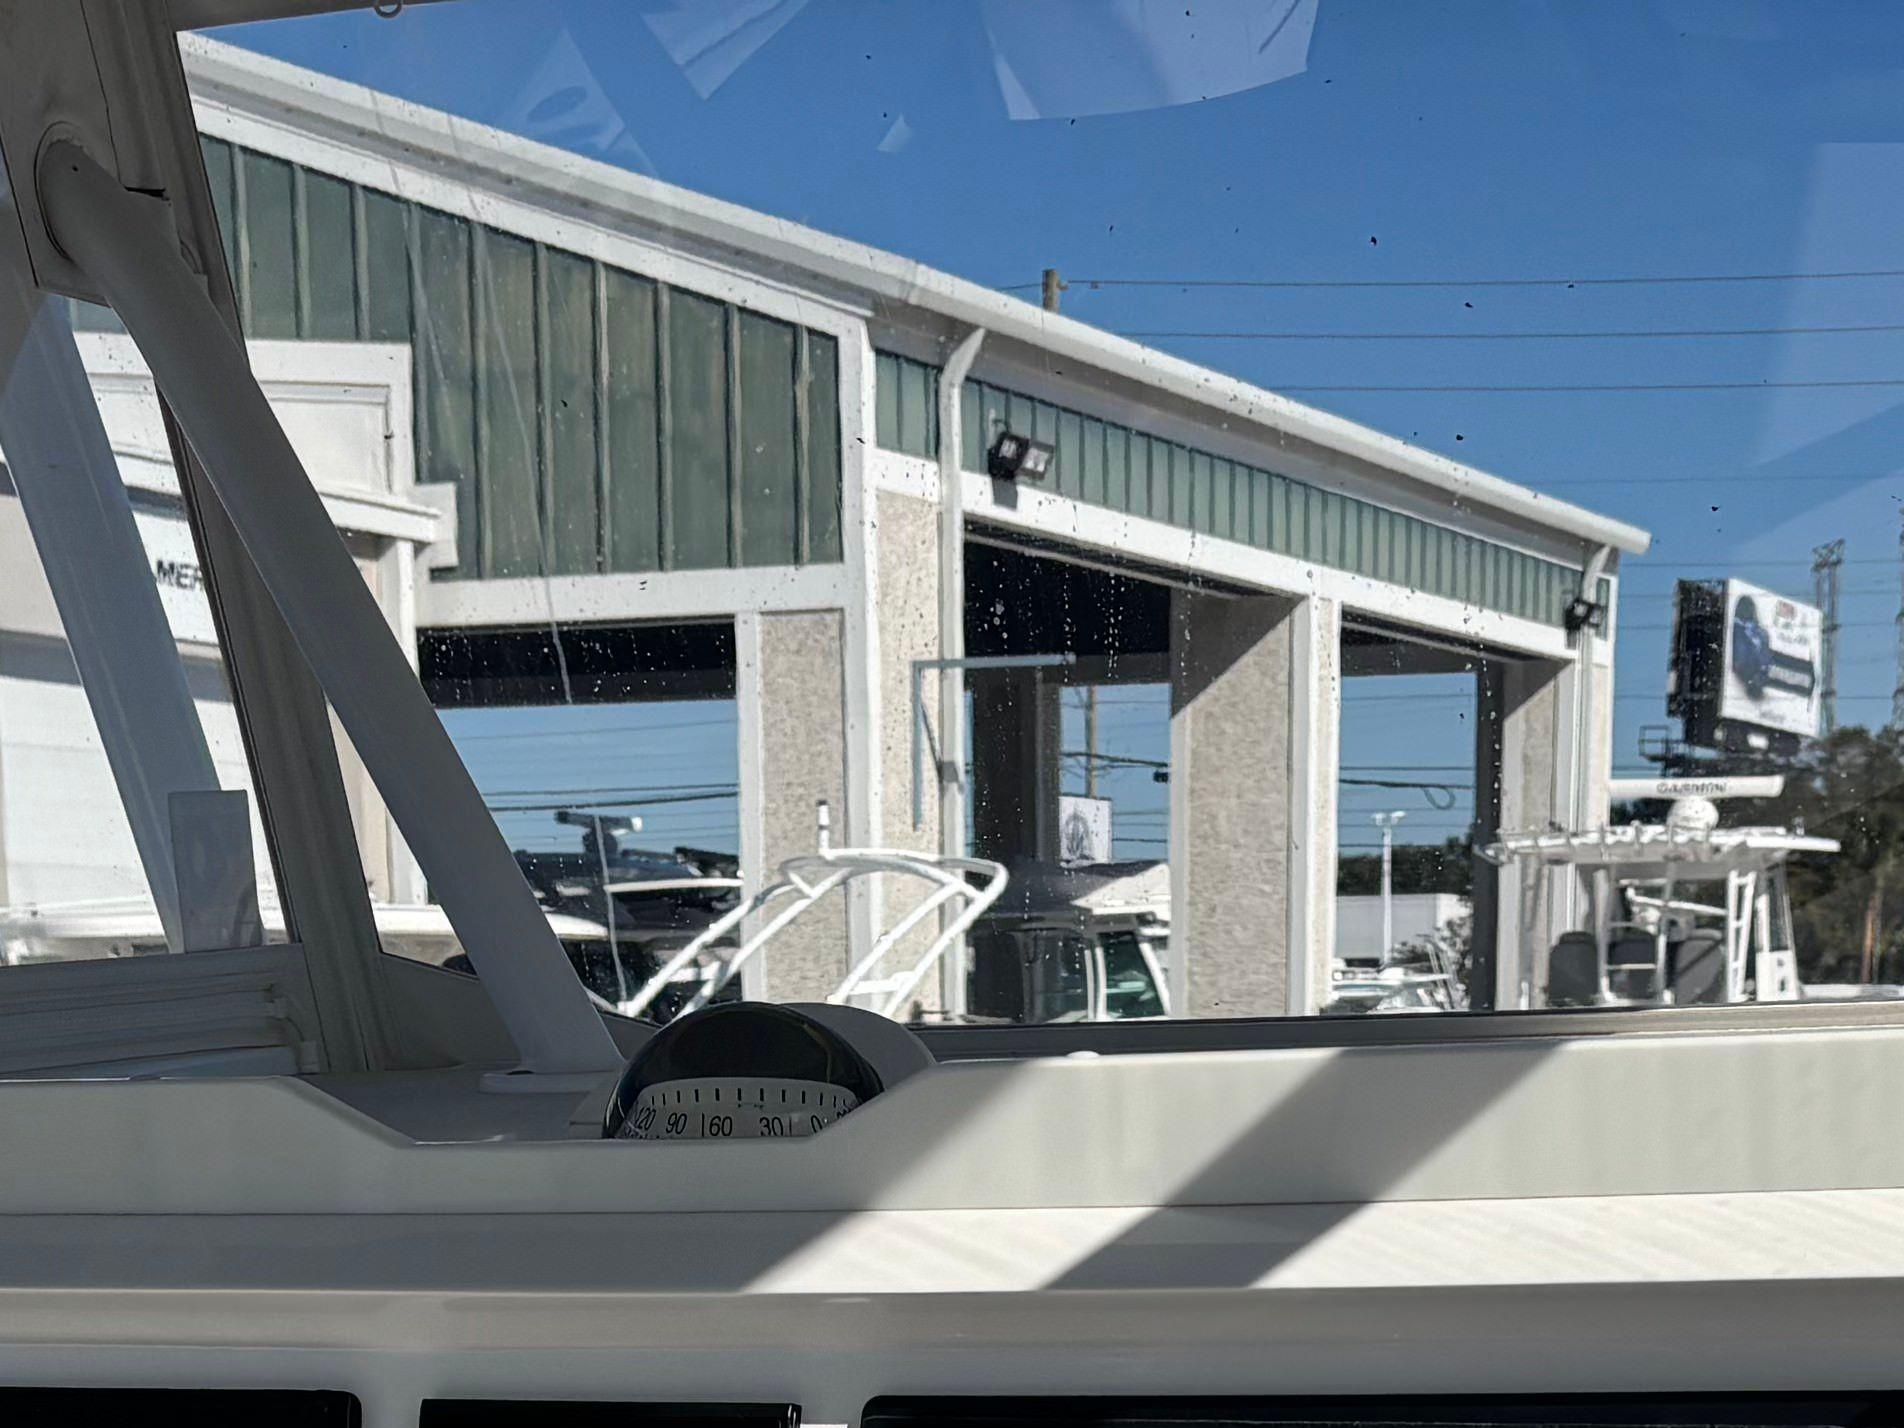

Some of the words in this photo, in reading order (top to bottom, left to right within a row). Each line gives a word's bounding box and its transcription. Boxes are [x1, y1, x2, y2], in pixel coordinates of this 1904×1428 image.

[666, 1113, 688, 1134] 90
[709, 1116, 733, 1137] 60
[760, 1116, 784, 1137] 30
